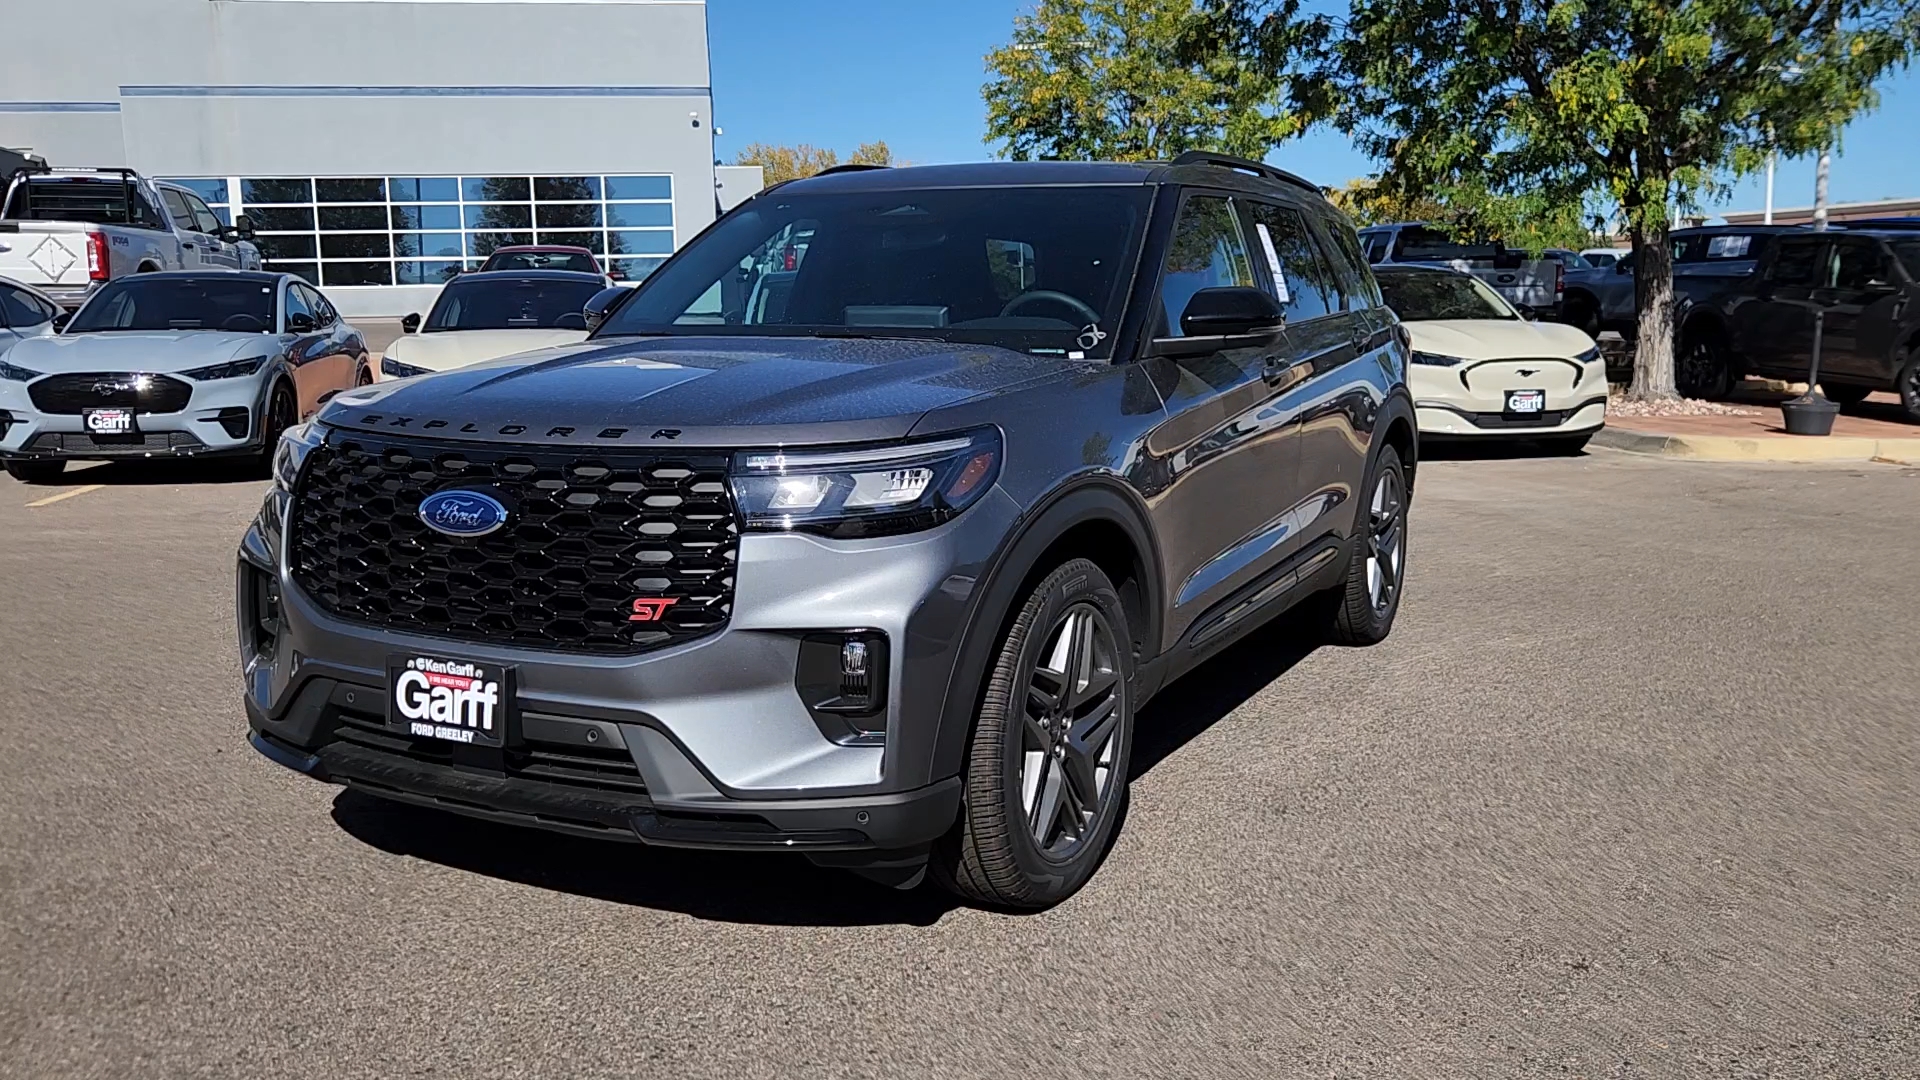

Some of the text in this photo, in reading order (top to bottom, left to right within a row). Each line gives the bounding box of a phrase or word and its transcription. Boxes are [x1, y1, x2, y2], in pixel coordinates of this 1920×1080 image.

[1508, 395, 1543, 410] Garff
[87, 413, 131, 430] Garff
[359, 414, 682, 441] EXPLORER
[435, 498, 485, 527] Ford
[628, 597, 680, 621] ST
[396, 670, 498, 730] Garff
[411, 722, 474, 743] FORD GREELEY
